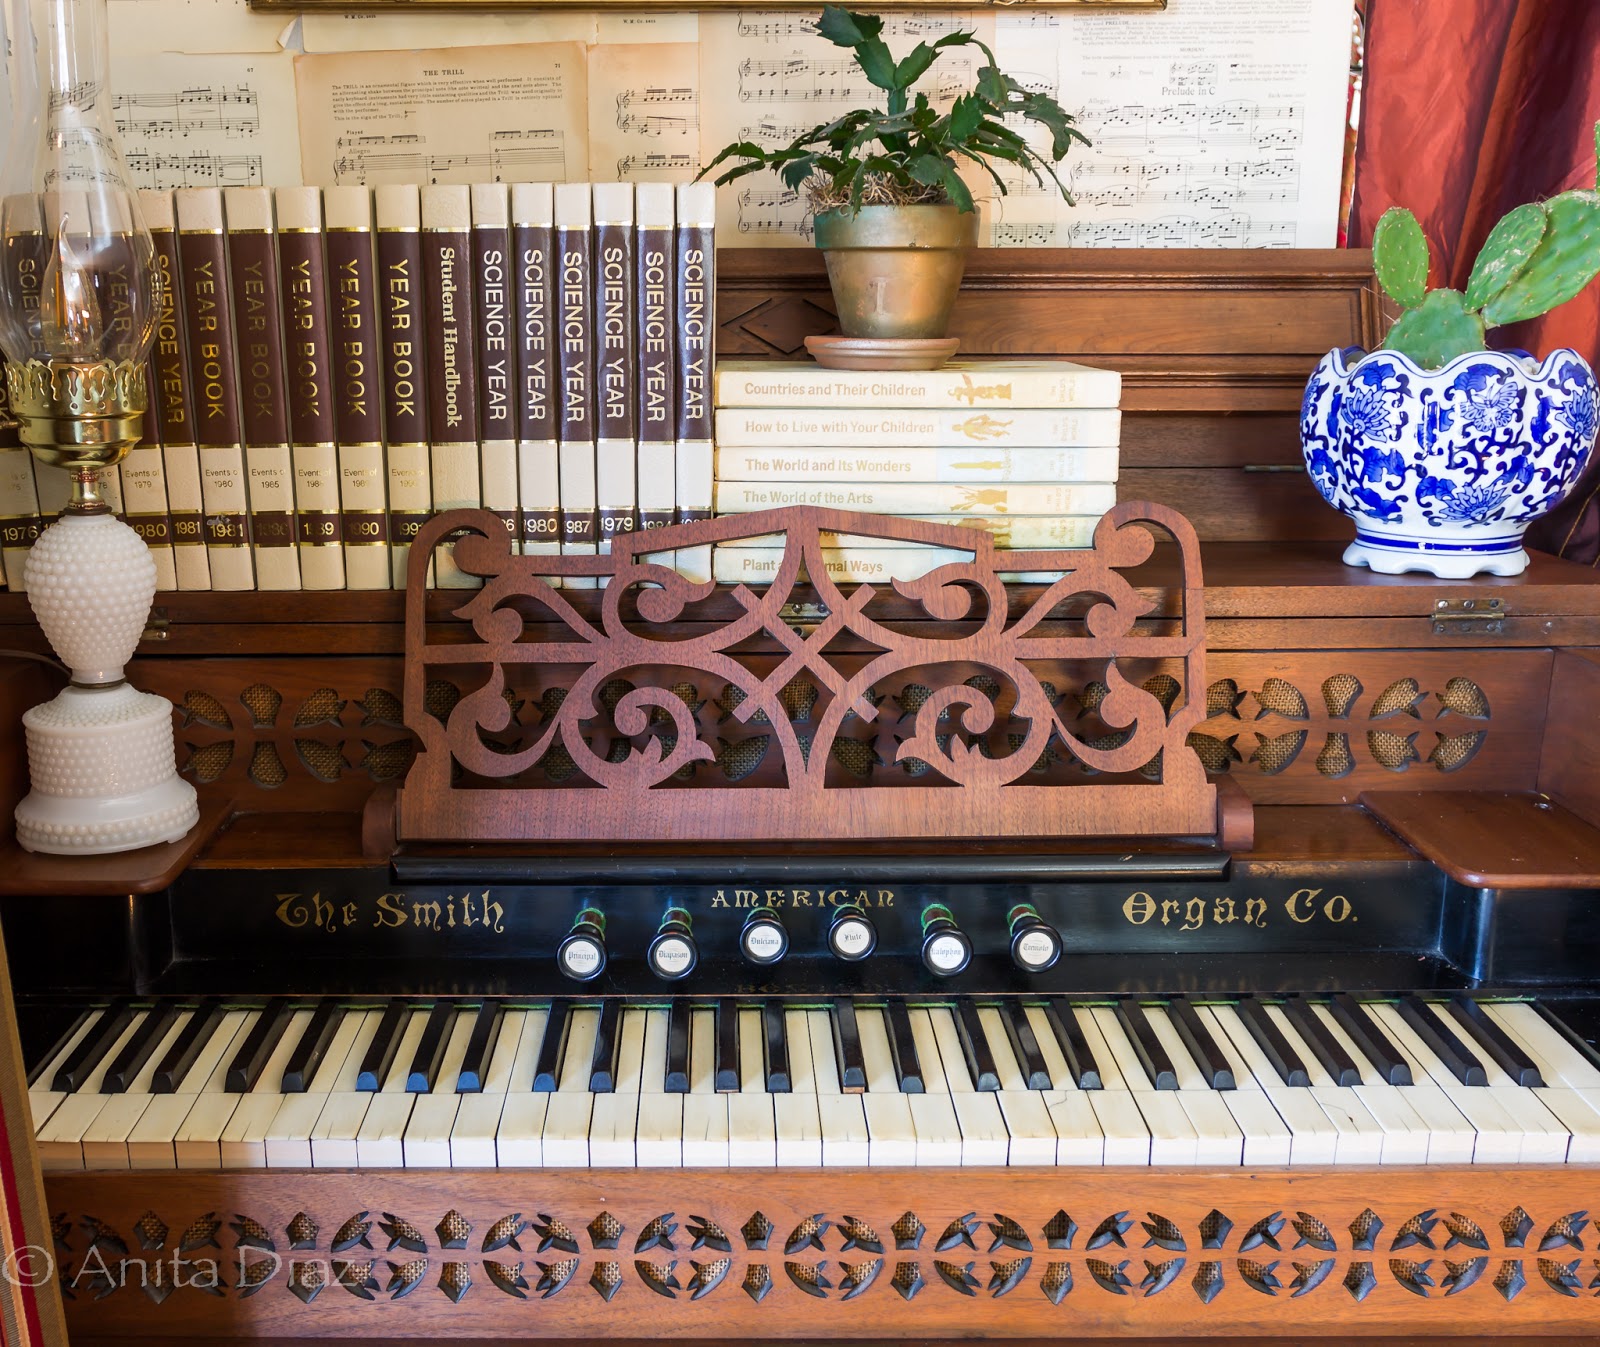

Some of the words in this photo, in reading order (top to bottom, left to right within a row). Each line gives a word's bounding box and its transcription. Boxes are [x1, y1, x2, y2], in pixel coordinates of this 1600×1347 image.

[1162, 86, 1195, 96] Prelude
[1198, 87, 1206, 95] in
[1209, 86, 1216, 95] C
[108, 264, 132, 332] YEAR
[158, 254, 179, 355] SCIENCE
[194, 260, 218, 331] YEAR
[244, 260, 266, 331] YEAR
[291, 259, 314, 330] YEAR
[340, 258, 362, 329] YEAR
[390, 258, 411, 329] YEAR
[440, 247, 458, 322] Student
[483, 250, 505, 351] SCIENCE
[524, 250, 545, 351] SCIENCE
[564, 251, 584, 353] SCIENCE
[604, 248, 624, 350] SCIENCE
[645, 251, 665, 353] SCIENCE
[684, 249, 704, 350] SCIENCE
[163, 362, 186, 424] YEAR
[201, 344, 225, 418] BOOK
[250, 343, 273, 418] BOOK
[298, 342, 320, 417] BOOK
[344, 342, 367, 417] BOOK
[393, 342, 415, 417] BOOK
[443, 327, 463, 428] Handbook
[488, 360, 507, 420] YEAR
[527, 358, 546, 420] YEAR
[566, 361, 585, 422] YEAR
[606, 358, 624, 418] YEAR
[647, 362, 666, 422] YEAR
[685, 358, 704, 420] YEAR
[744, 382, 806, 395] Countries
[808, 383, 832, 396] and
[835, 383, 868, 396] Their
[871, 384, 926, 396] Children
[745, 421, 773, 433] How
[776, 422, 788, 433] to
[792, 421, 818, 433] Live
[821, 421, 848, 433] with
[850, 422, 878, 433] Your
[880, 421, 934, 433] Children
[125, 470, 150, 478] Events
[205, 469, 231, 477] Events
[746, 459, 769, 471] The
[772, 459, 809, 471] World
[812, 459, 835, 471] and
[838, 459, 853, 471] Its
[856, 460, 912, 472] Wonders
[523, 518, 558, 533] 1980
[600, 517, 633, 531] 1979
[743, 490, 767, 503] The
[770, 490, 806, 503] World
[810, 491, 822, 504] of
[824, 492, 844, 504] the
[847, 492, 873, 504] Arts
[3, 526, 38, 541] 1976
[132, 523, 167, 537] 980
[175, 522, 200, 534] 1981
[210, 523, 243, 537] 1981
[400, 522, 424, 536] 99
[743, 558, 776, 572] Plant
[849, 560, 883, 574] Ways
[275, 890, 358, 933] The
[373, 890, 505, 934] Smith
[711, 889, 894, 908] AMERICAN
[1122, 891, 1268, 931] Organ
[1284, 888, 1359, 923] Co.
[568, 952, 596, 961] Principal
[658, 950, 688, 960] Diapason
[750, 937, 779, 945] Dulciana
